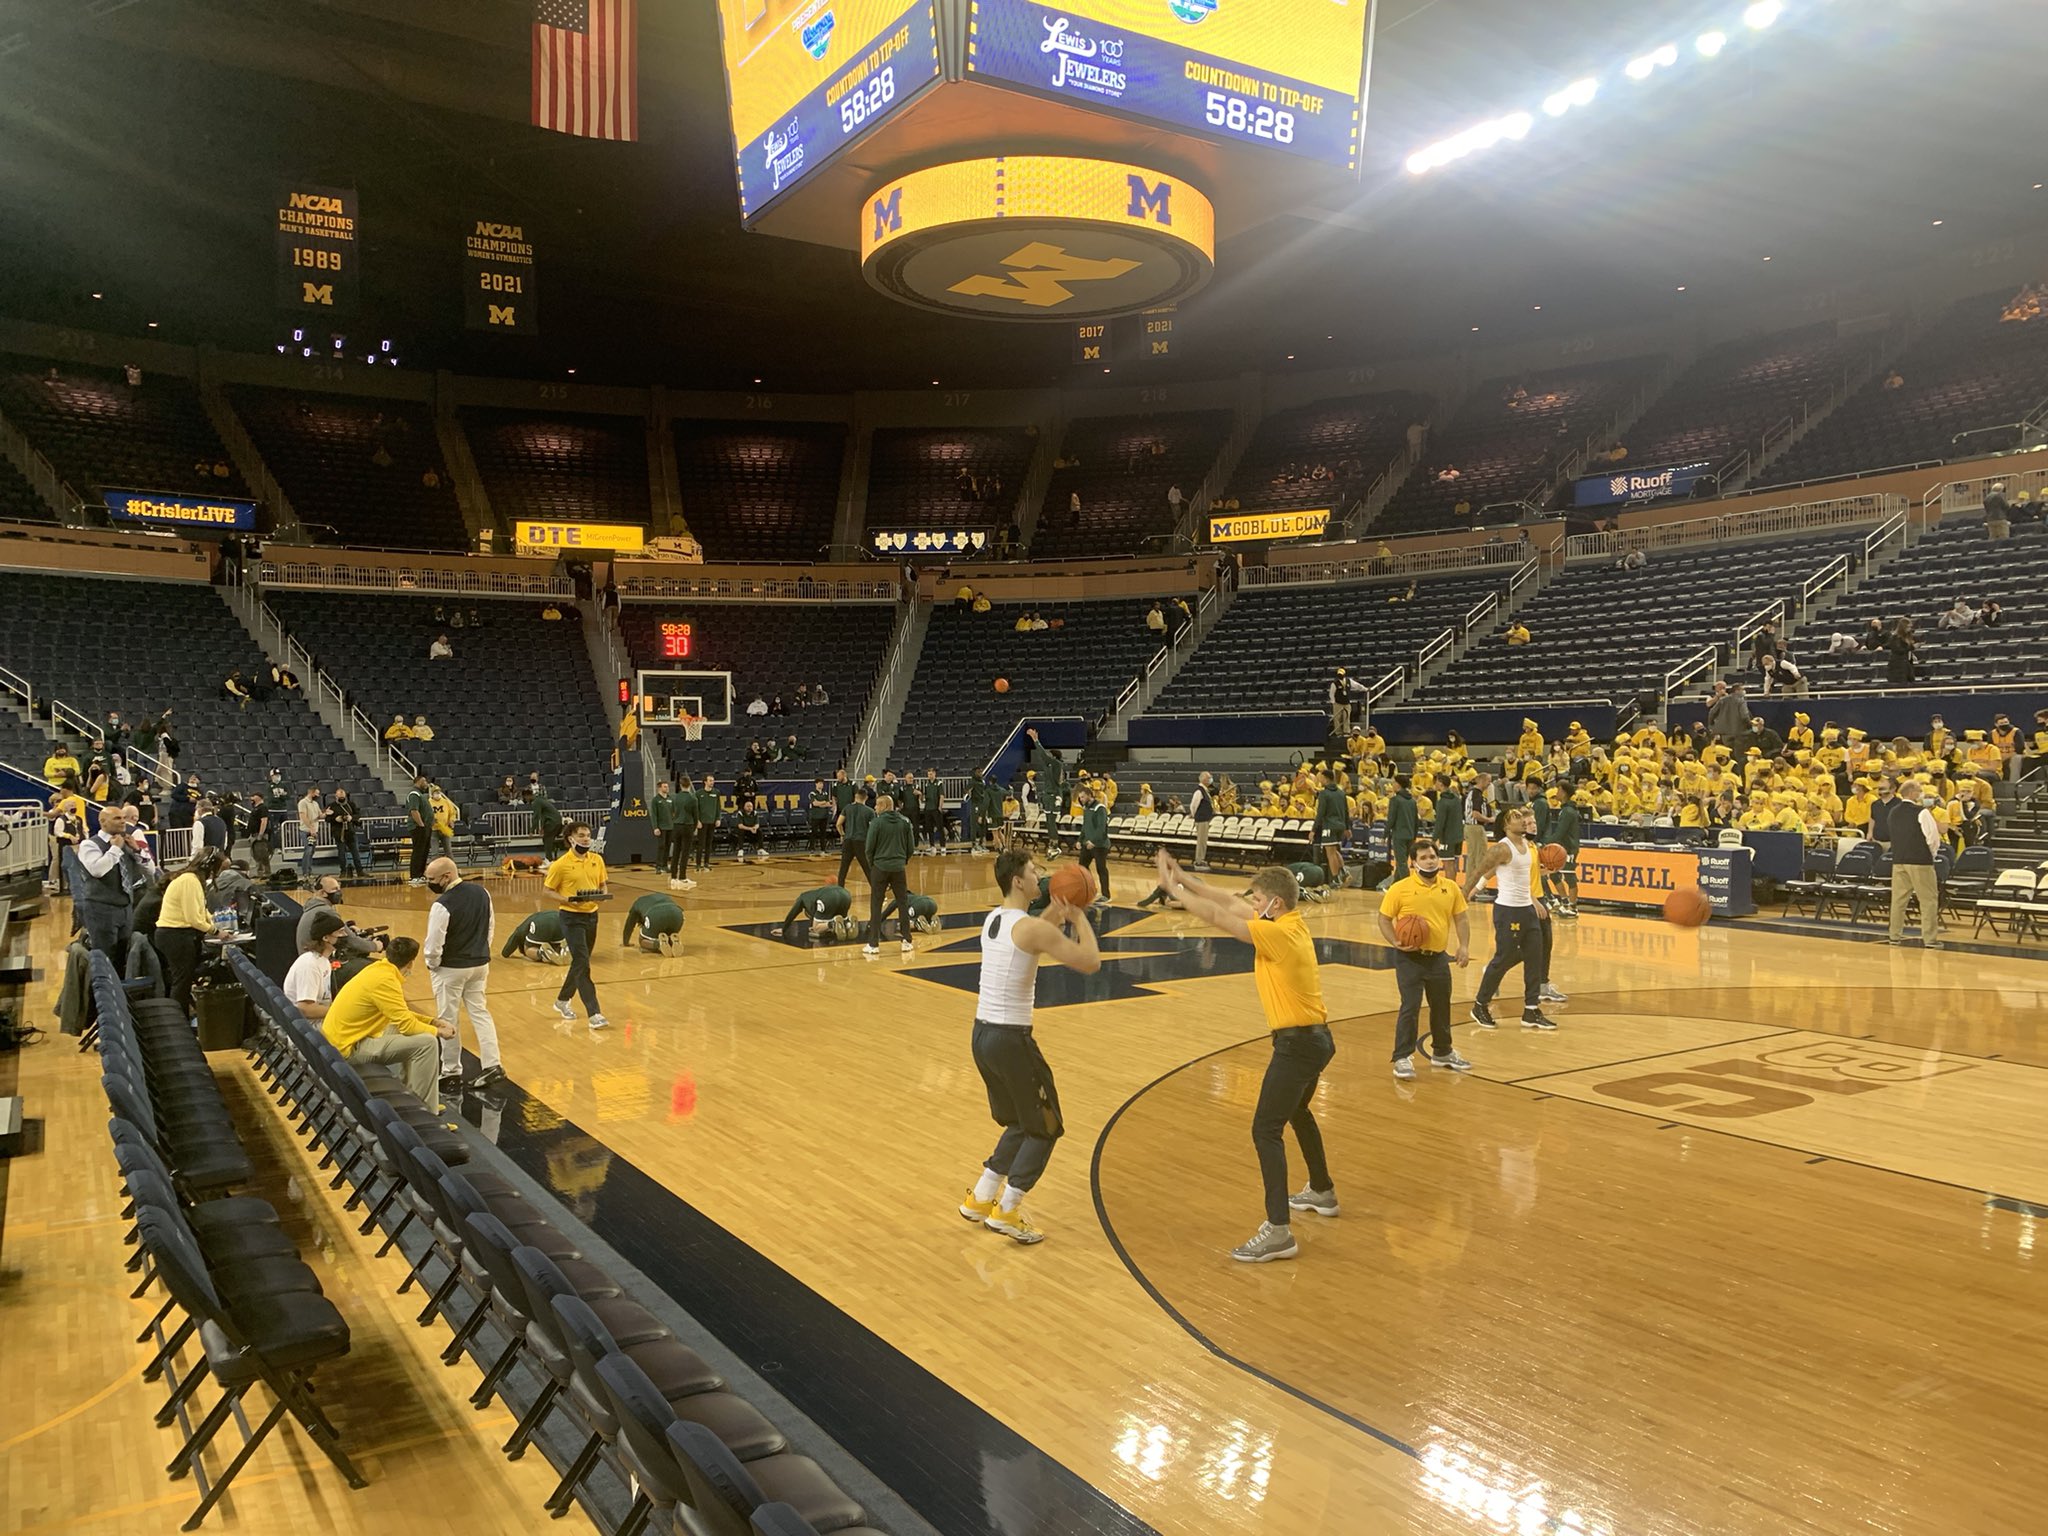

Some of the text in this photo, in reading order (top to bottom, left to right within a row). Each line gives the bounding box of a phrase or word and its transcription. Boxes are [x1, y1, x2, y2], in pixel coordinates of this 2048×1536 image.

[1099, 39, 1124, 58] 100
[826, 58, 869, 107] COUNTDOWN
[869, 50, 880, 72] TO
[880, 24, 909, 64] TIP-OFF
[1101, 55, 1121, 67] YEARS
[1052, 52, 1126, 90] JEWELERS
[1184, 60, 1324, 114] COUNTDOWN TO TIP-OFF
[841, 66, 895, 133] 58:28
[1205, 91, 1295, 144] 58:28
[773, 143, 804, 190] JEWELERS
[289, 192, 343, 215] NCAA
[1127, 174, 1172, 226] M
[279, 208, 354, 231] CHAMPIONS
[874, 187, 903, 242] M
[280, 222, 354, 240] MEN'S BASKETBALL
[476, 221, 523, 241] NCAA
[466, 236, 533, 256] CHAMPIONS
[293, 248, 342, 271] 1989
[467, 249, 533, 265] WOMEN'S GYMNASTICS
[480, 272, 523, 294] 2021
[303, 282, 333, 305] M
[488, 304, 515, 326] M
[293, 329, 302, 342] 0
[1079, 326, 1105, 339] 2017
[1147, 320, 1173, 333] 2021
[381, 340, 390, 352] 0
[1083, 346, 1100, 360] M
[1152, 341, 1169, 354] M
[539, 385, 568, 400] 215
[944, 393, 971, 407] 217
[746, 395, 773, 409] 216
[1631, 472, 1673, 490] Ruoff
[127, 499, 236, 524] #CrislerLIVE
[528, 525, 582, 545] DTE
[586, 533, 632, 543] MiGreenPower
[662, 624, 691, 636] 58:28
[665, 636, 688, 656] 30
[433, 805, 444, 813] M
[623, 809, 648, 818] UMCU
[1710, 858, 1730, 866] Ruoff
[1577, 862, 1675, 890] ETBALL
[1709, 876, 1729, 885] Ruoff
[1709, 895, 1728, 904] Ruoff
[1510, 922, 1521, 932] M
